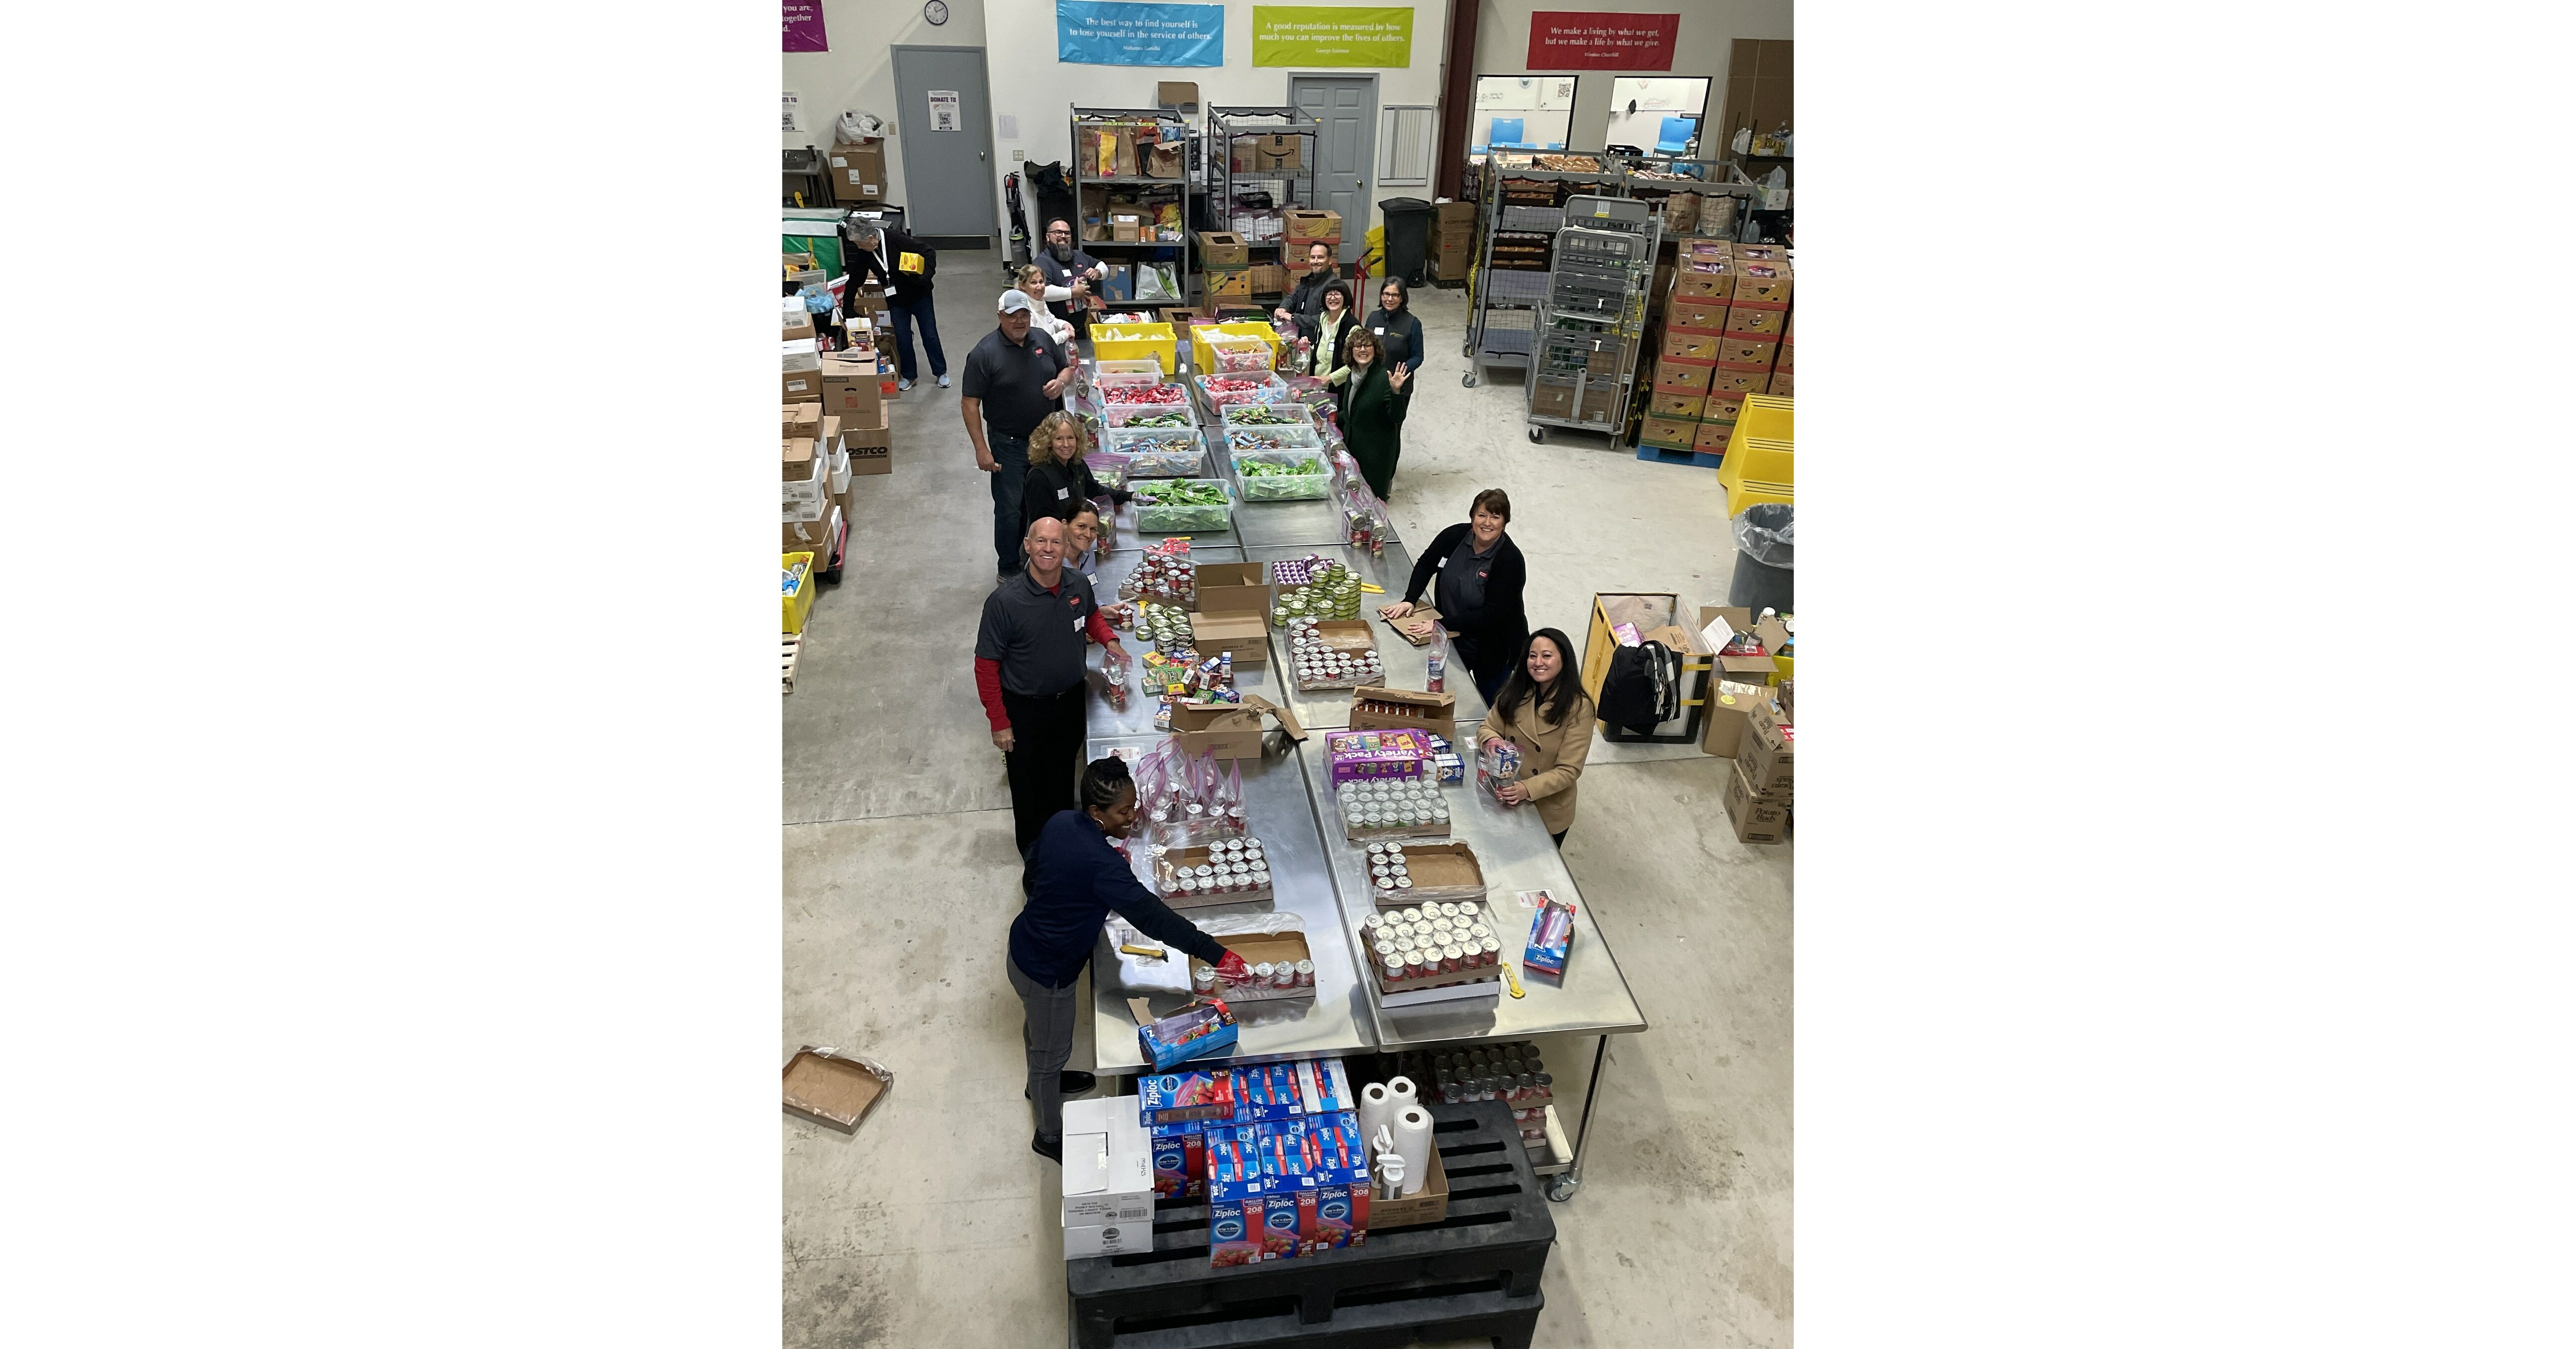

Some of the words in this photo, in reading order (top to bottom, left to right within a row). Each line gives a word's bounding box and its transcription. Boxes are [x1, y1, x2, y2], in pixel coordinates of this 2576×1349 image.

[1161, 20, 1190, 28] yourself
[1273, 22, 1291, 31] good
[1293, 22, 1330, 32] reputation
[1376, 23, 1384, 32] by
[1096, 29, 1126, 39] yourself
[1187, 31, 1212, 40] others.
[1589, 27, 1607, 37] living
[1608, 28, 1616, 37] by
[1311, 33, 1340, 43] improve
[1372, 33, 1380, 42] of
[1607, 38, 1615, 47] by
[1344, 751, 1373, 760] Pack
[1374, 749, 1417, 758] Variety
[1755, 807, 1781, 816] Potato
[1536, 954, 1554, 964] Ziploc
[1147, 1079, 1162, 1106] Ziploc
[1155, 1143, 1180, 1151] Ziploc
[1322, 1191, 1348, 1200] Ziploc
[1268, 1200, 1294, 1209] Ziploc
[1214, 1210, 1241, 1219] Ziploc
